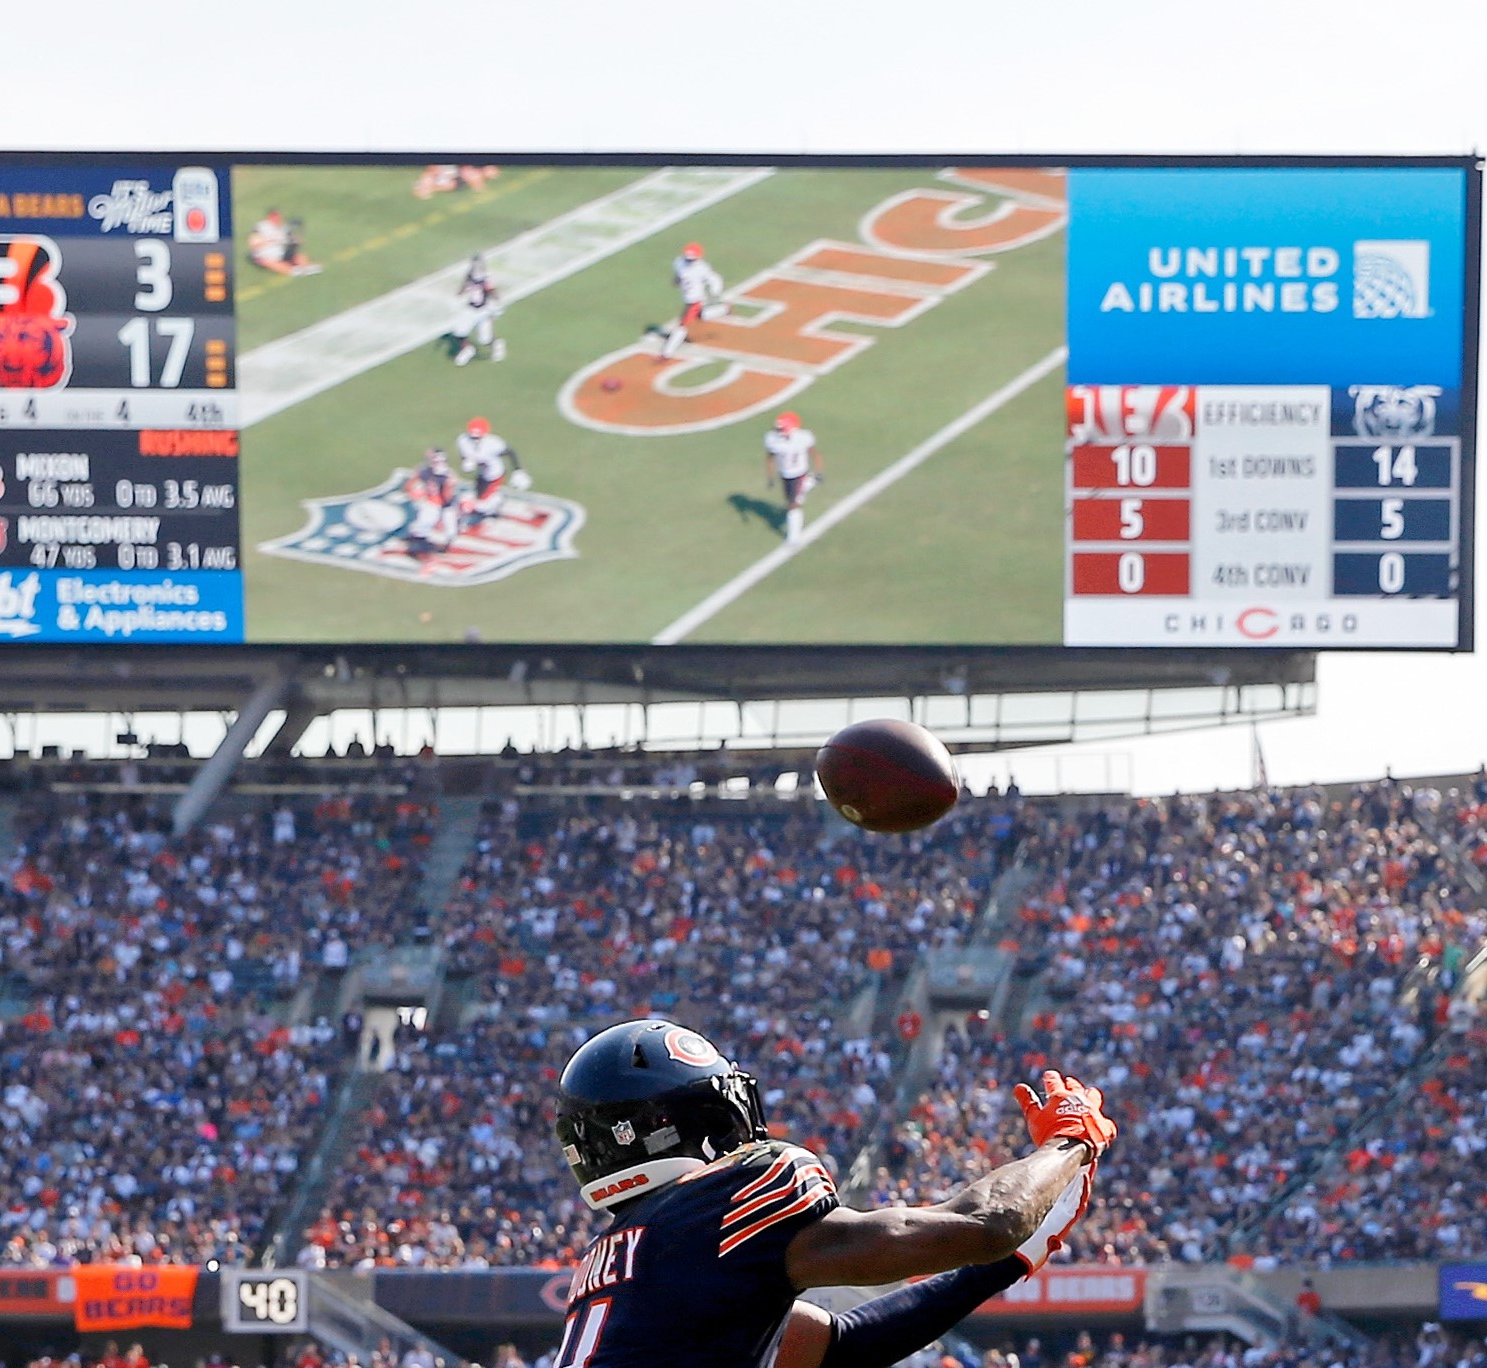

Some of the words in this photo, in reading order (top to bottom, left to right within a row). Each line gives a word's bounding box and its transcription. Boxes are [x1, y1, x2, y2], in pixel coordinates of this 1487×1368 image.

[13, 193, 85, 218] BEARS
[133, 238, 174, 312] 3
[1148, 246, 1340, 278] UNITED
[557, 167, 1068, 436] CHIC
[1099, 281, 1340, 313] AIRLINES
[117, 316, 195, 388] 17
[1204, 403, 1321, 426] EFFICIENCY
[16, 453, 90, 481] MIXON
[1111, 444, 1157, 488] 10
[1242, 456, 1317, 480] DOWNS
[1372, 444, 1419, 488] 14
[164, 479, 199, 509] 3.5
[17, 515, 161, 544] MONTGOMERY
[1119, 498, 1145, 541] 5
[1380, 498, 1406, 542] 5
[30, 542, 61, 569] 47
[166, 542, 201, 570] 3.1
[1118, 551, 1146, 594] 0
[1378, 551, 1406, 594] 0
[56, 576, 200, 606] Electronics
[84, 604, 228, 637] Appliances
[114, 1272, 159, 1291] GO
[239, 1278, 297, 1324] 40
